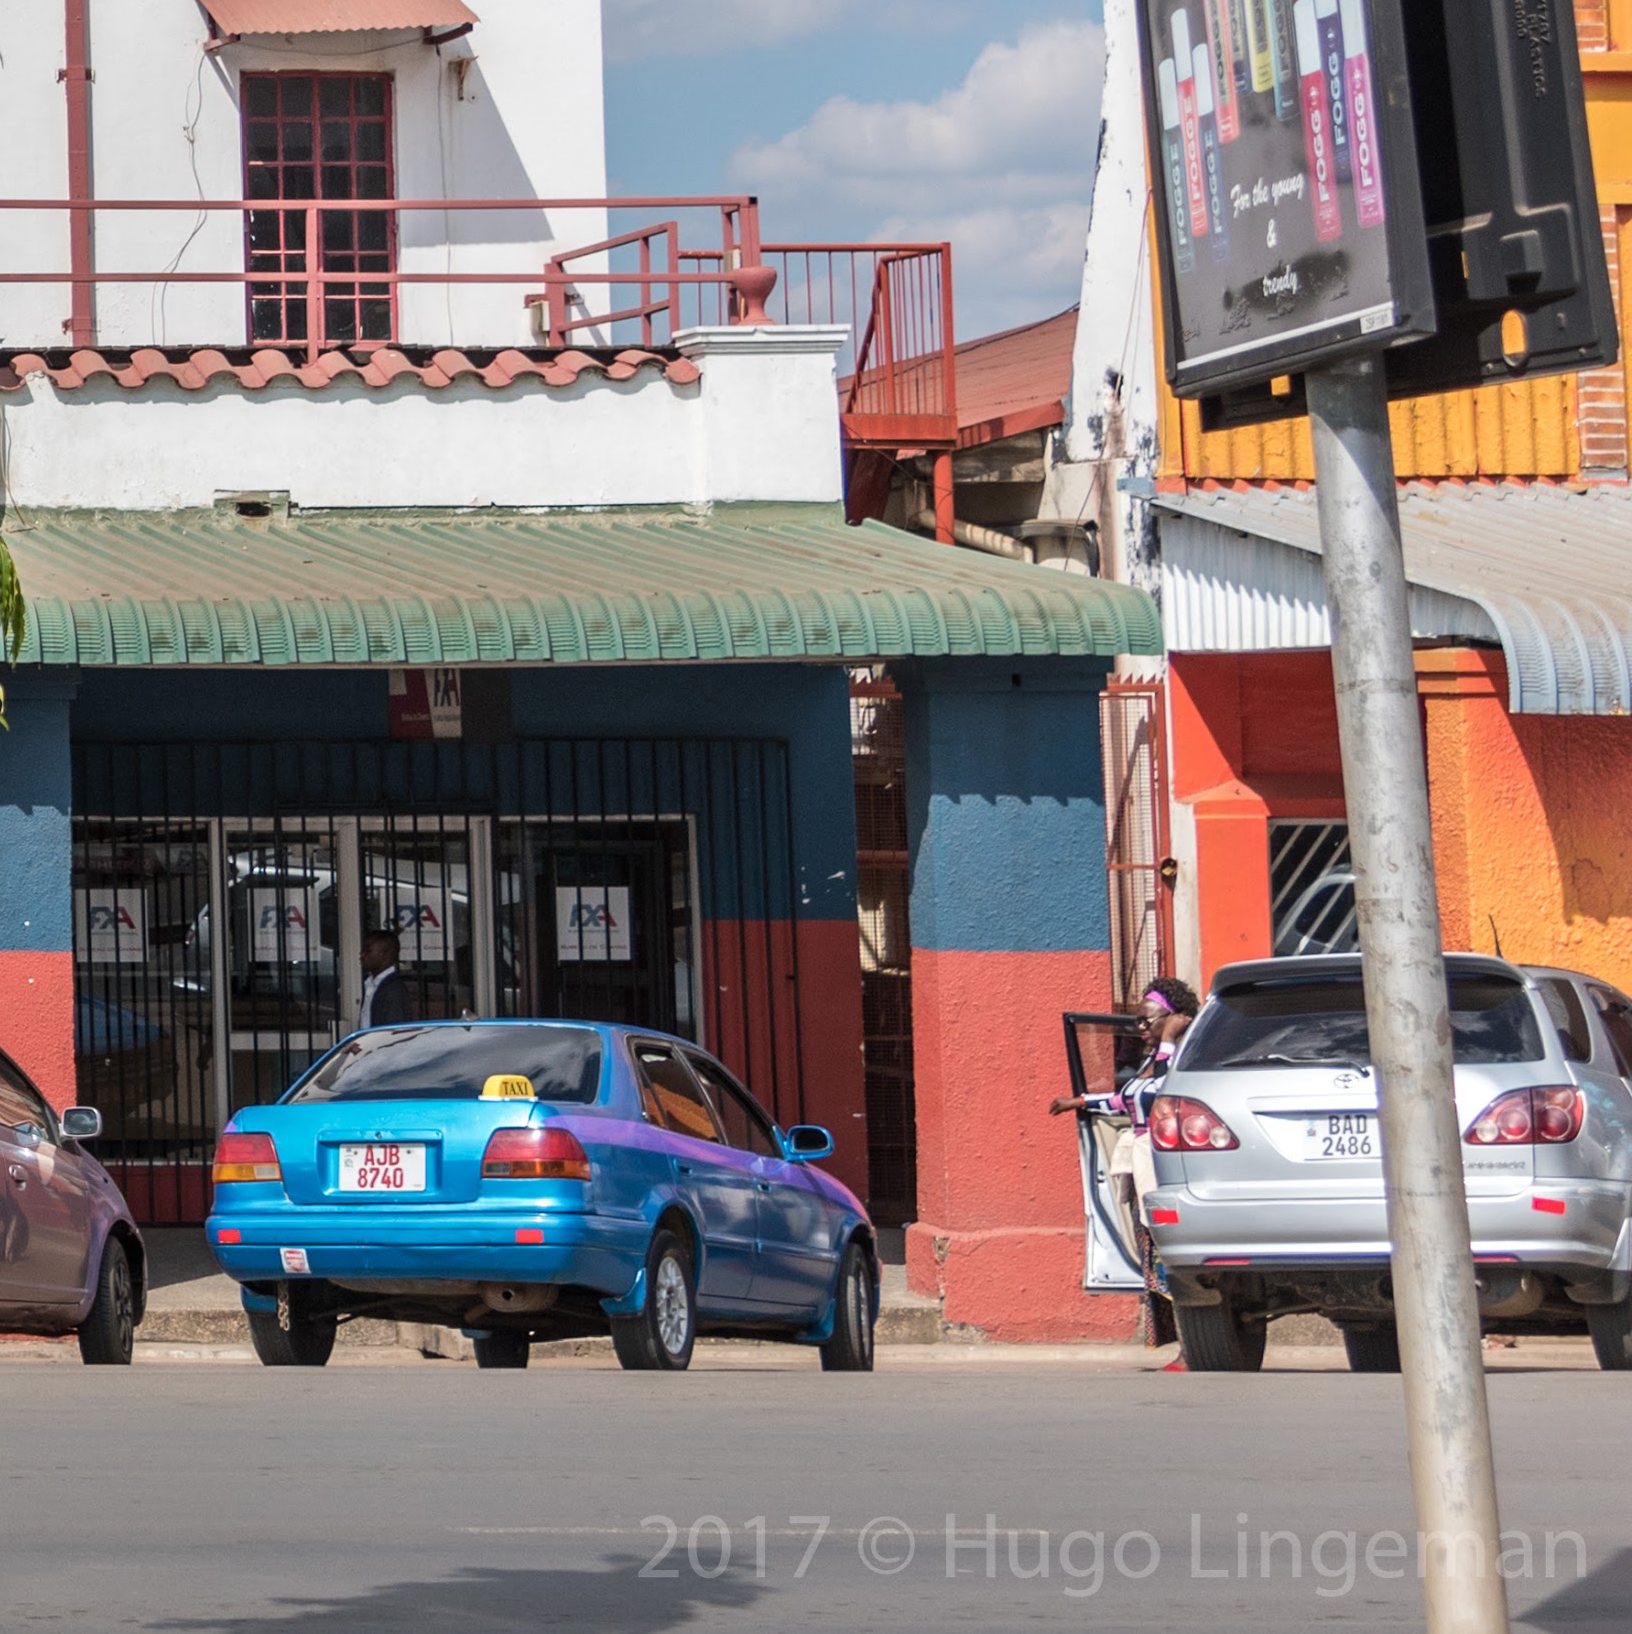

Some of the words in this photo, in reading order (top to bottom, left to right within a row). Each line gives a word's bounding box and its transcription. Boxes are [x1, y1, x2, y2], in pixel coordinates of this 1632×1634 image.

[1328, 51, 1345, 145] FOGG
[1354, 94, 1373, 187] FOGG
[1310, 109, 1330, 202] FOGG
[1230, 184, 1250, 218] For
[1252, 177, 1269, 209] the
[1271, 173, 1304, 205] young
[1266, 218, 1277, 248] &
[1262, 265, 1298, 297] trendy
[569, 904, 617, 927] FXA
[502, 1081, 528, 1096] TAXI
[1328, 1115, 1367, 1135] BAD
[364, 1144, 400, 1166] AJB
[1322, 1137, 1372, 1156] 2486
[357, 1167, 404, 1189] 8740
